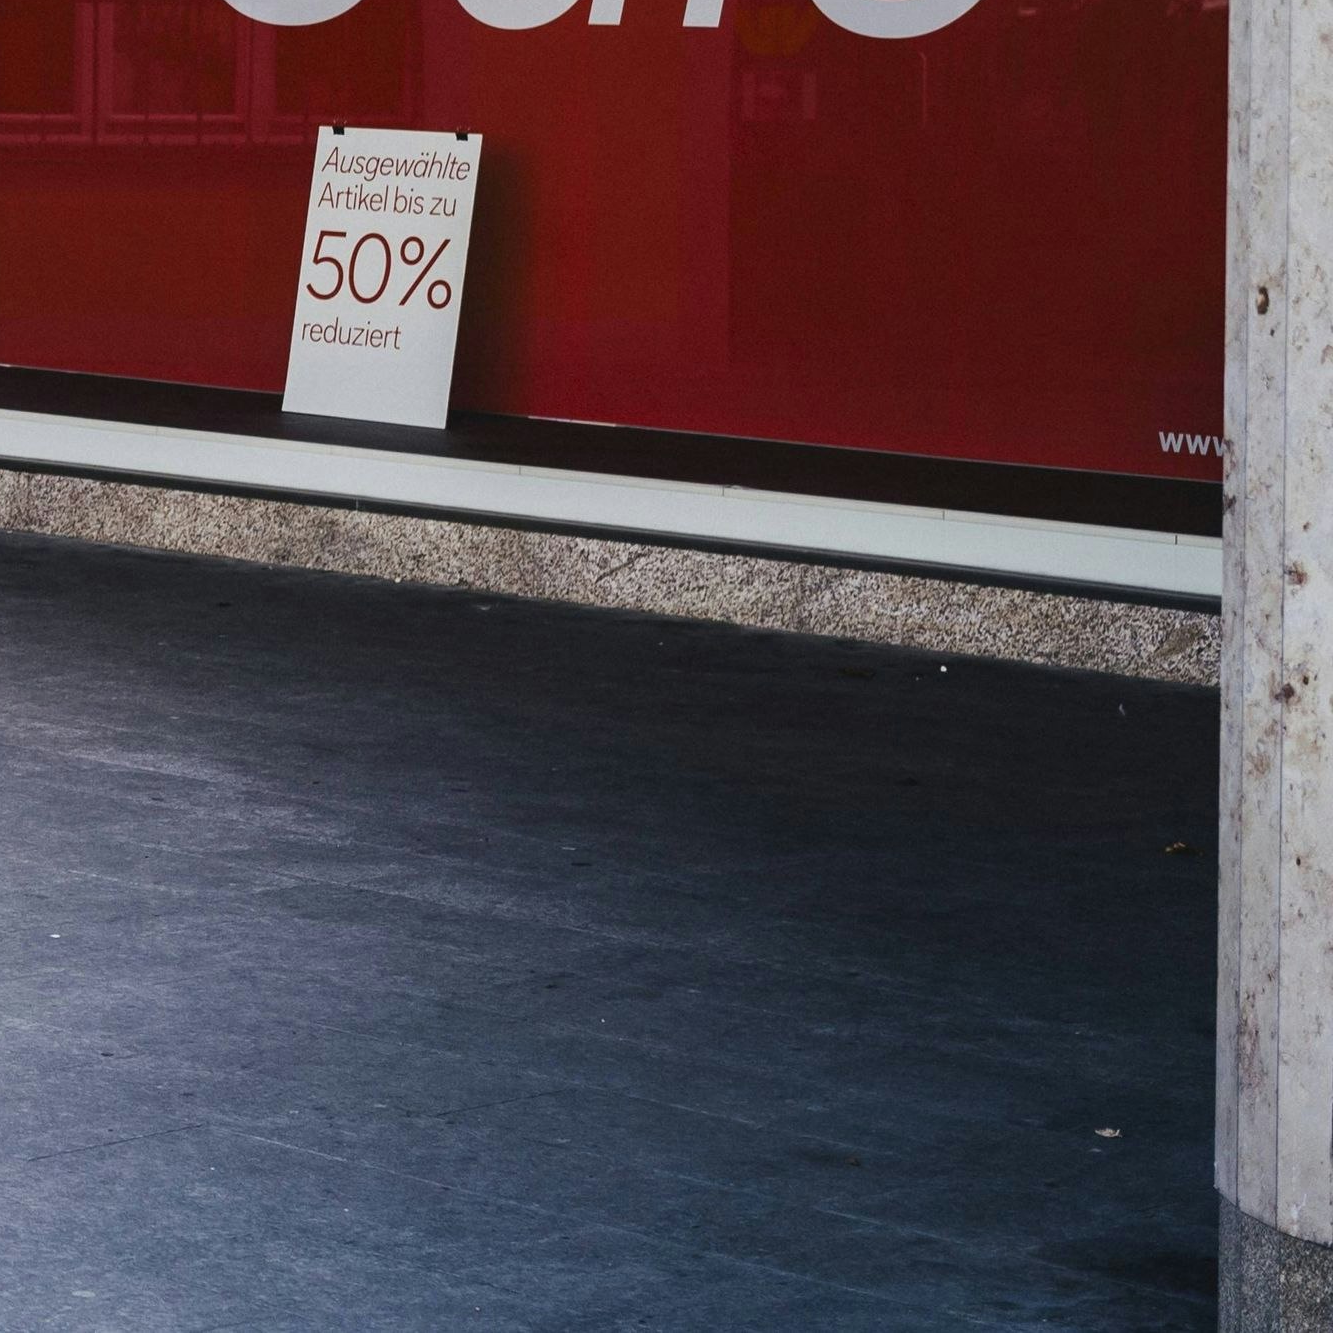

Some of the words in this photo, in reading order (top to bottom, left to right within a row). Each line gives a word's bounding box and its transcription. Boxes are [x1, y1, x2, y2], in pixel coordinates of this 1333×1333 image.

[321, 146, 471, 181] Ausgewählte
[318, 182, 389, 212] Artikel
[393, 186, 424, 215] bis
[429, 197, 457, 217] zu
[306, 230, 452, 310] 50%
[301, 317, 402, 350] reduziert
